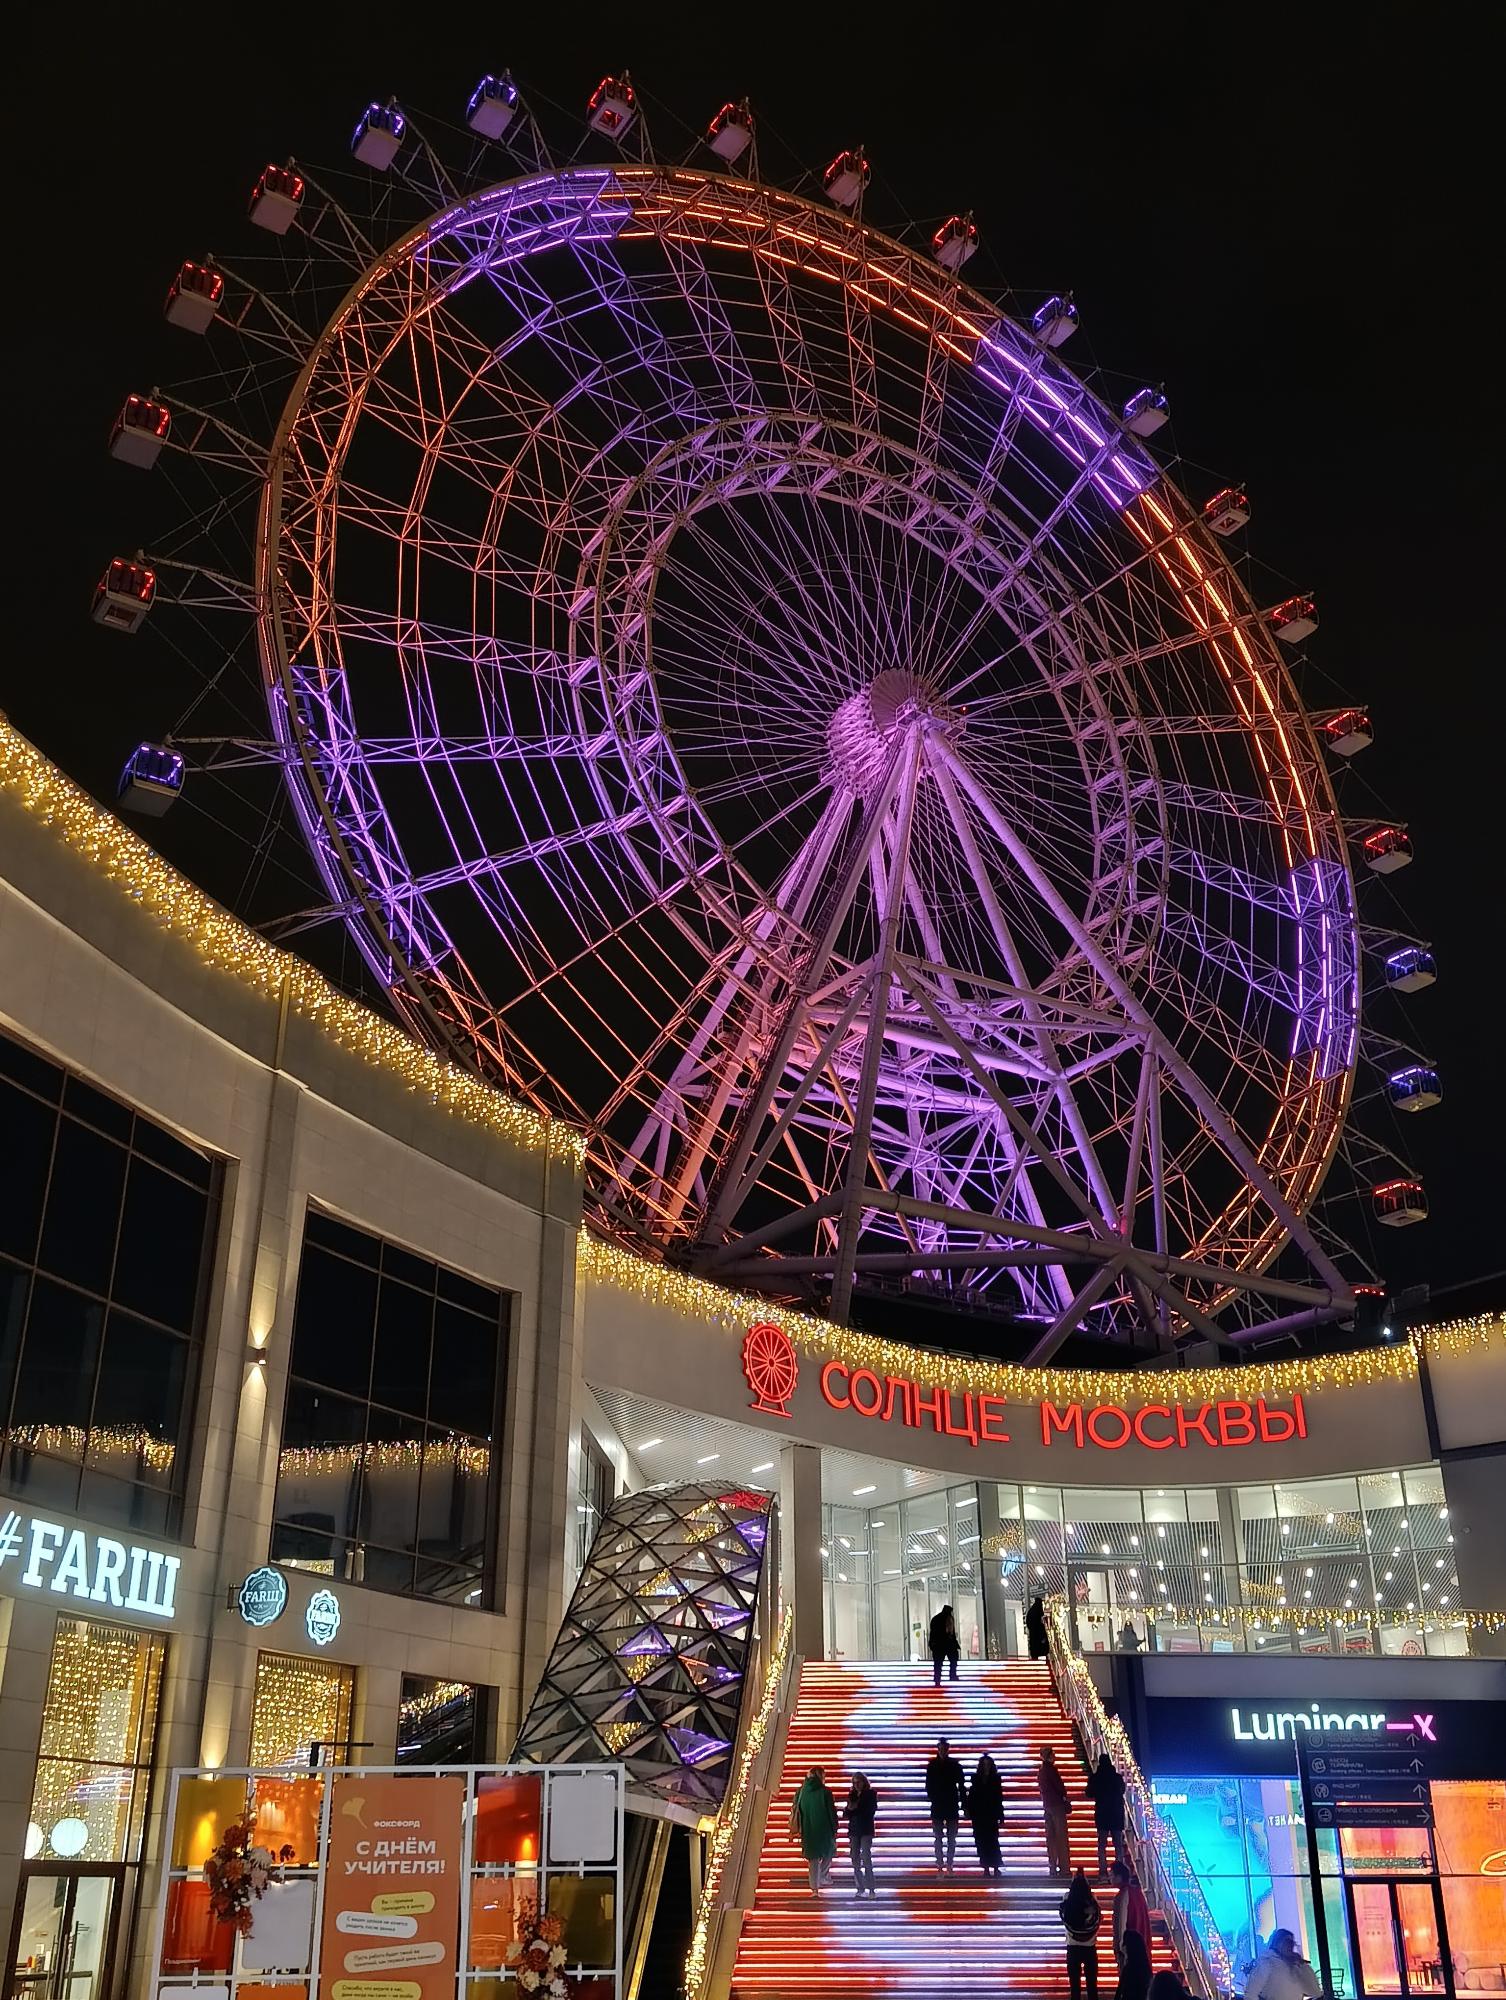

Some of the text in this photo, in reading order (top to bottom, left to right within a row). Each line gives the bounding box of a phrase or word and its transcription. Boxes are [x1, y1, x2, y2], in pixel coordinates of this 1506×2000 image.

[820, 1361, 1307, 1449] СОЛНЦЕ МОСКВЫ
[356, 1837, 436, 1857] С ДНЁМ
[344, 1859, 446, 1875] УЧИТЕЛЯ!
